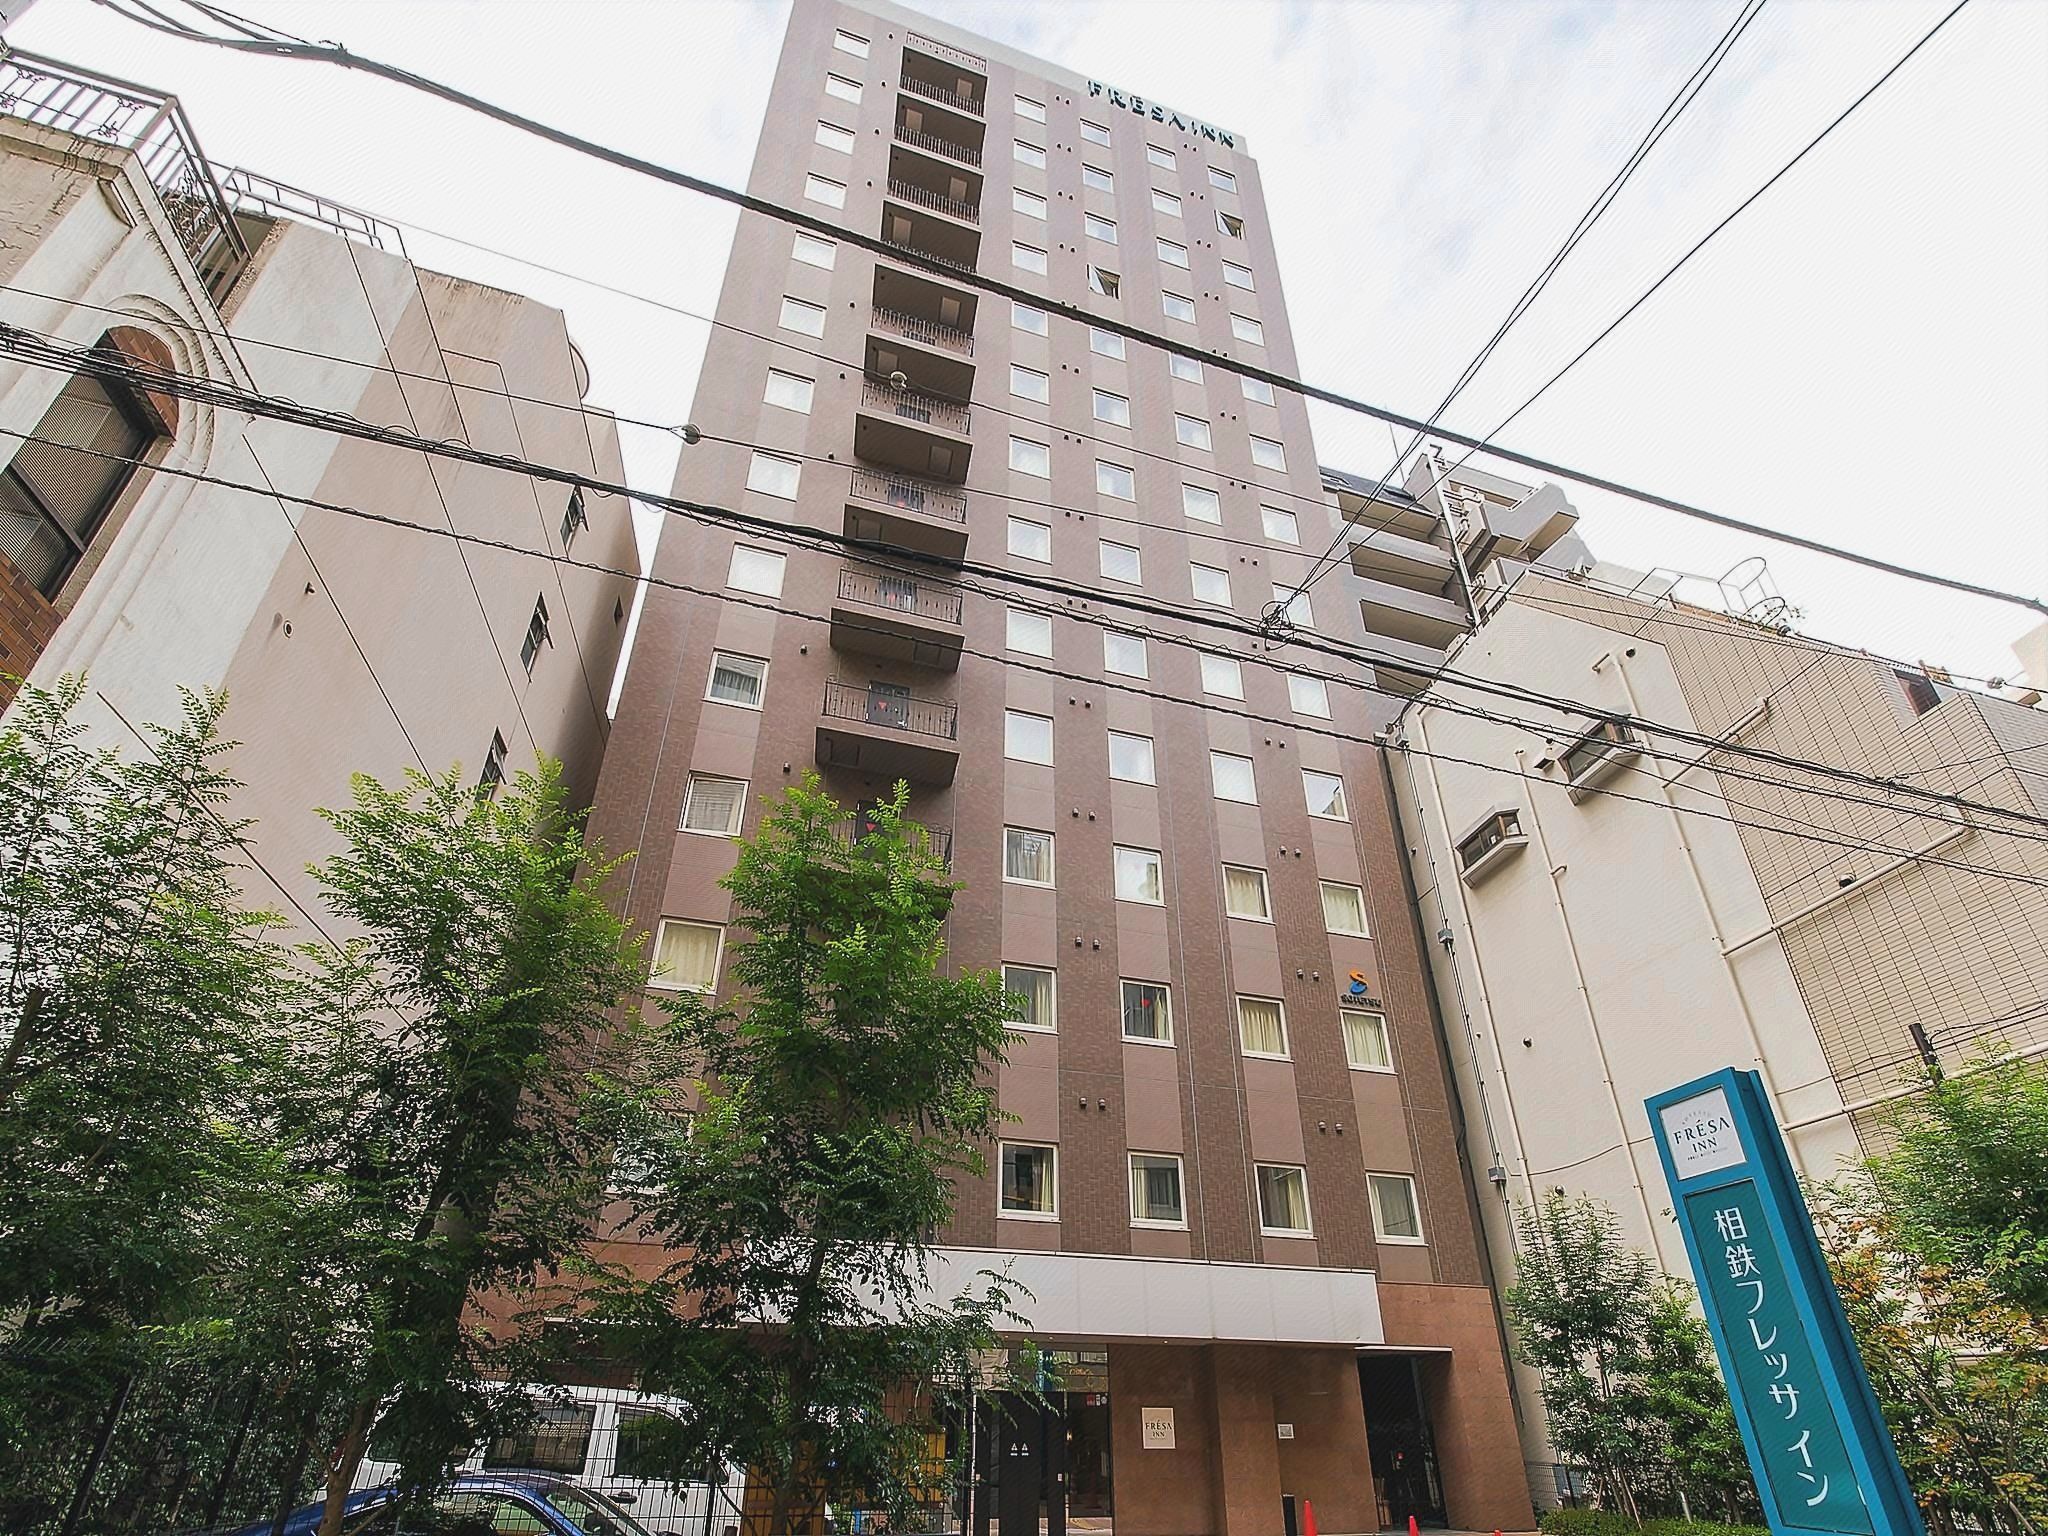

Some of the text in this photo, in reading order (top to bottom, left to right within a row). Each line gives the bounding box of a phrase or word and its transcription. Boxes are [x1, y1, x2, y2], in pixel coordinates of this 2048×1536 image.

[1192, 120, 1234, 149] INN
[1673, 1116, 1730, 1145] FRÉSA
[1692, 1137, 1718, 1153] INN
[1714, 1206, 1830, 1507] 相鉄フレッサイン
